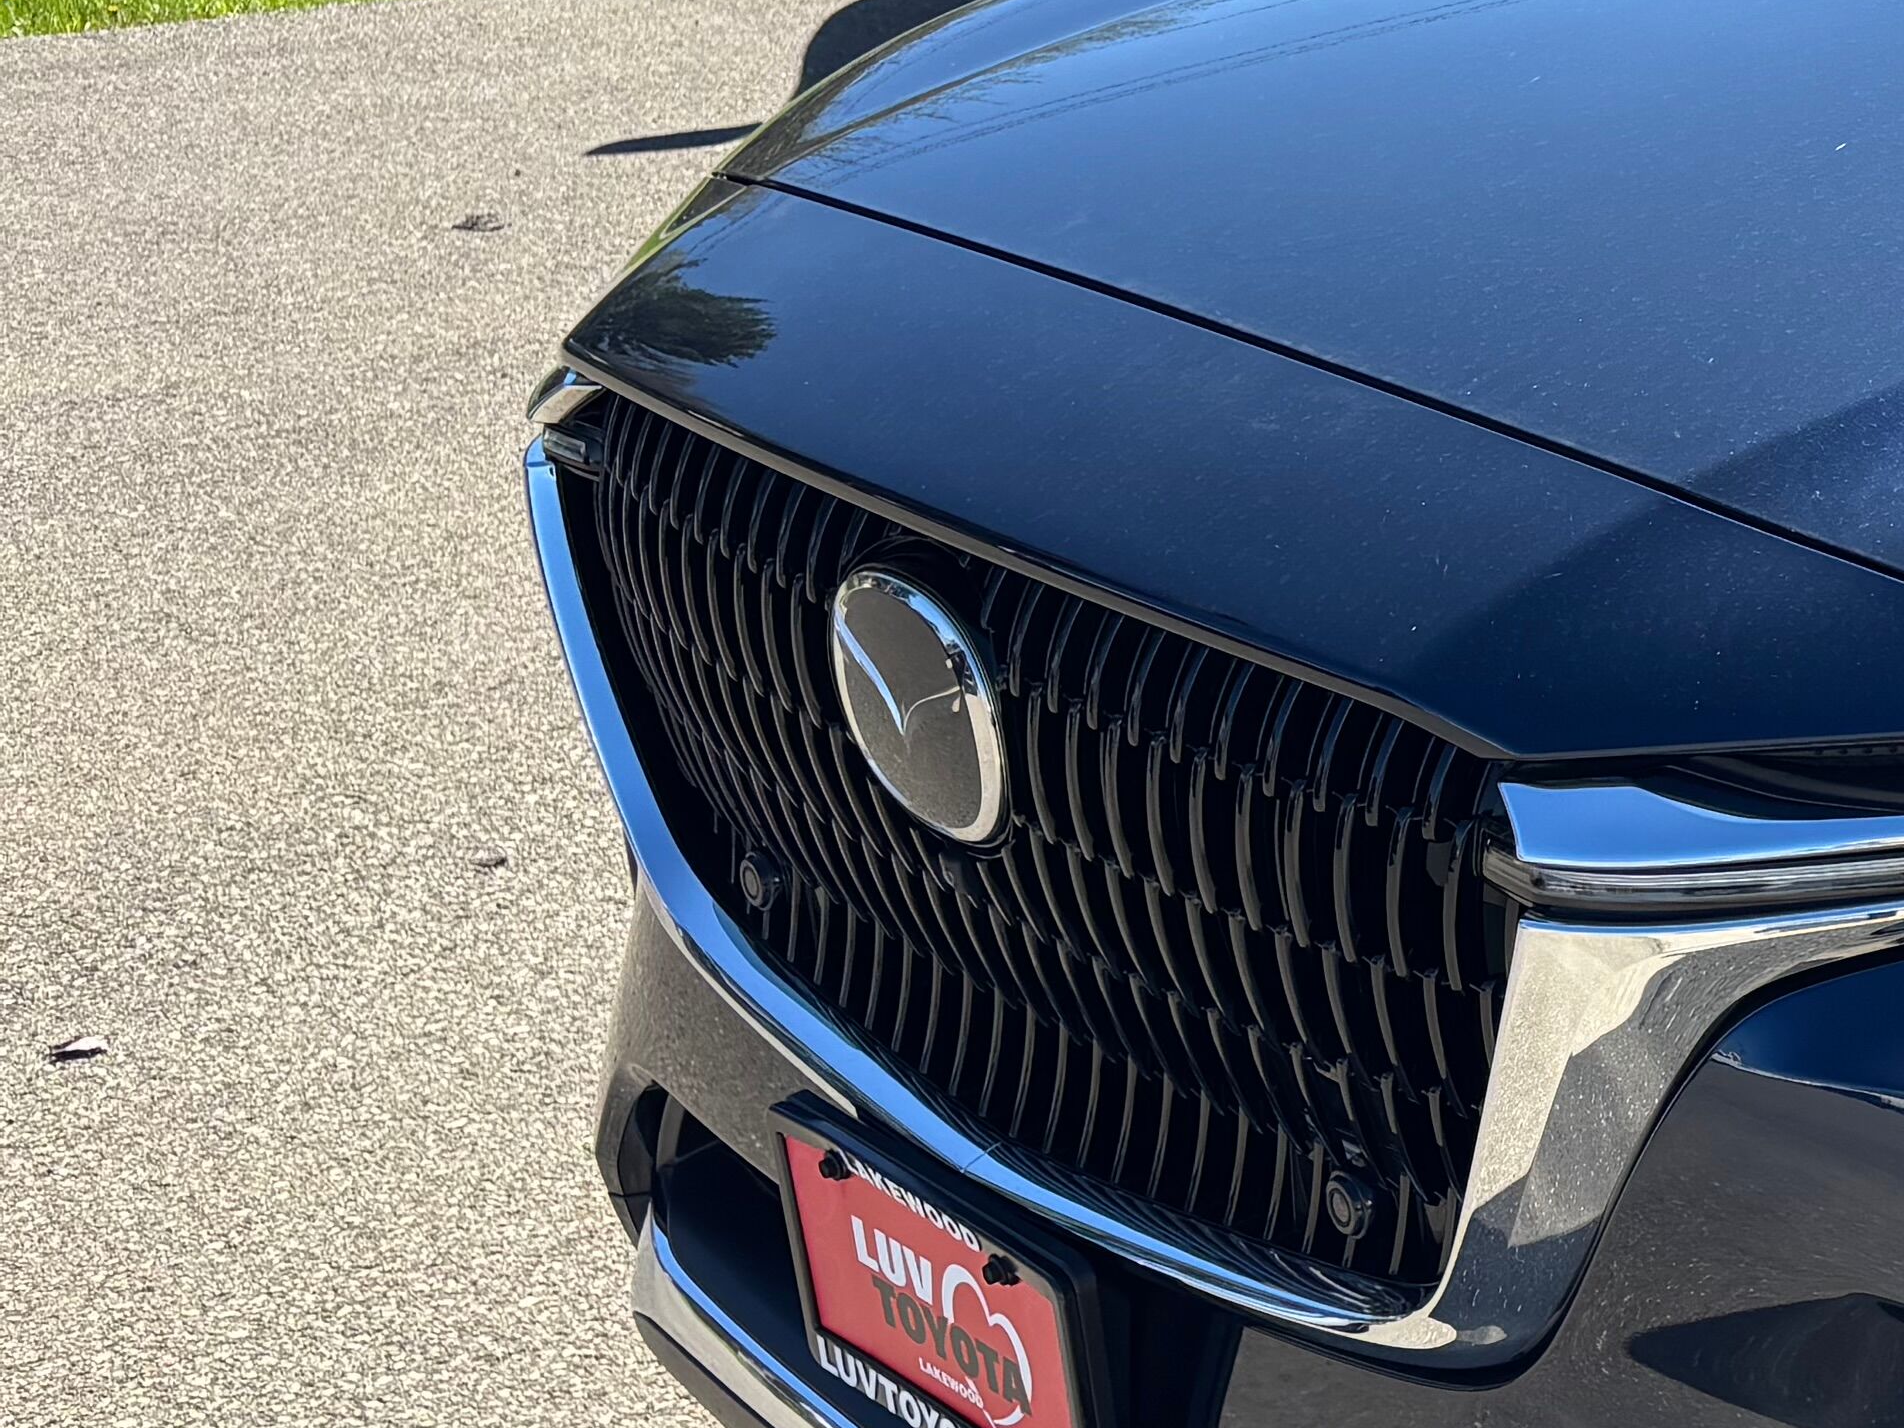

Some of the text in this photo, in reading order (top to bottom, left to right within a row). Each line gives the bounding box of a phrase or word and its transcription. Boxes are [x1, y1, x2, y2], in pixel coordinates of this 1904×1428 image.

[838, 1148, 982, 1253] LAKEWOOD
[850, 1214, 934, 1306] LUV
[871, 1273, 1032, 1417] TOYOTA
[918, 1356, 985, 1410] LAKEWOOD
